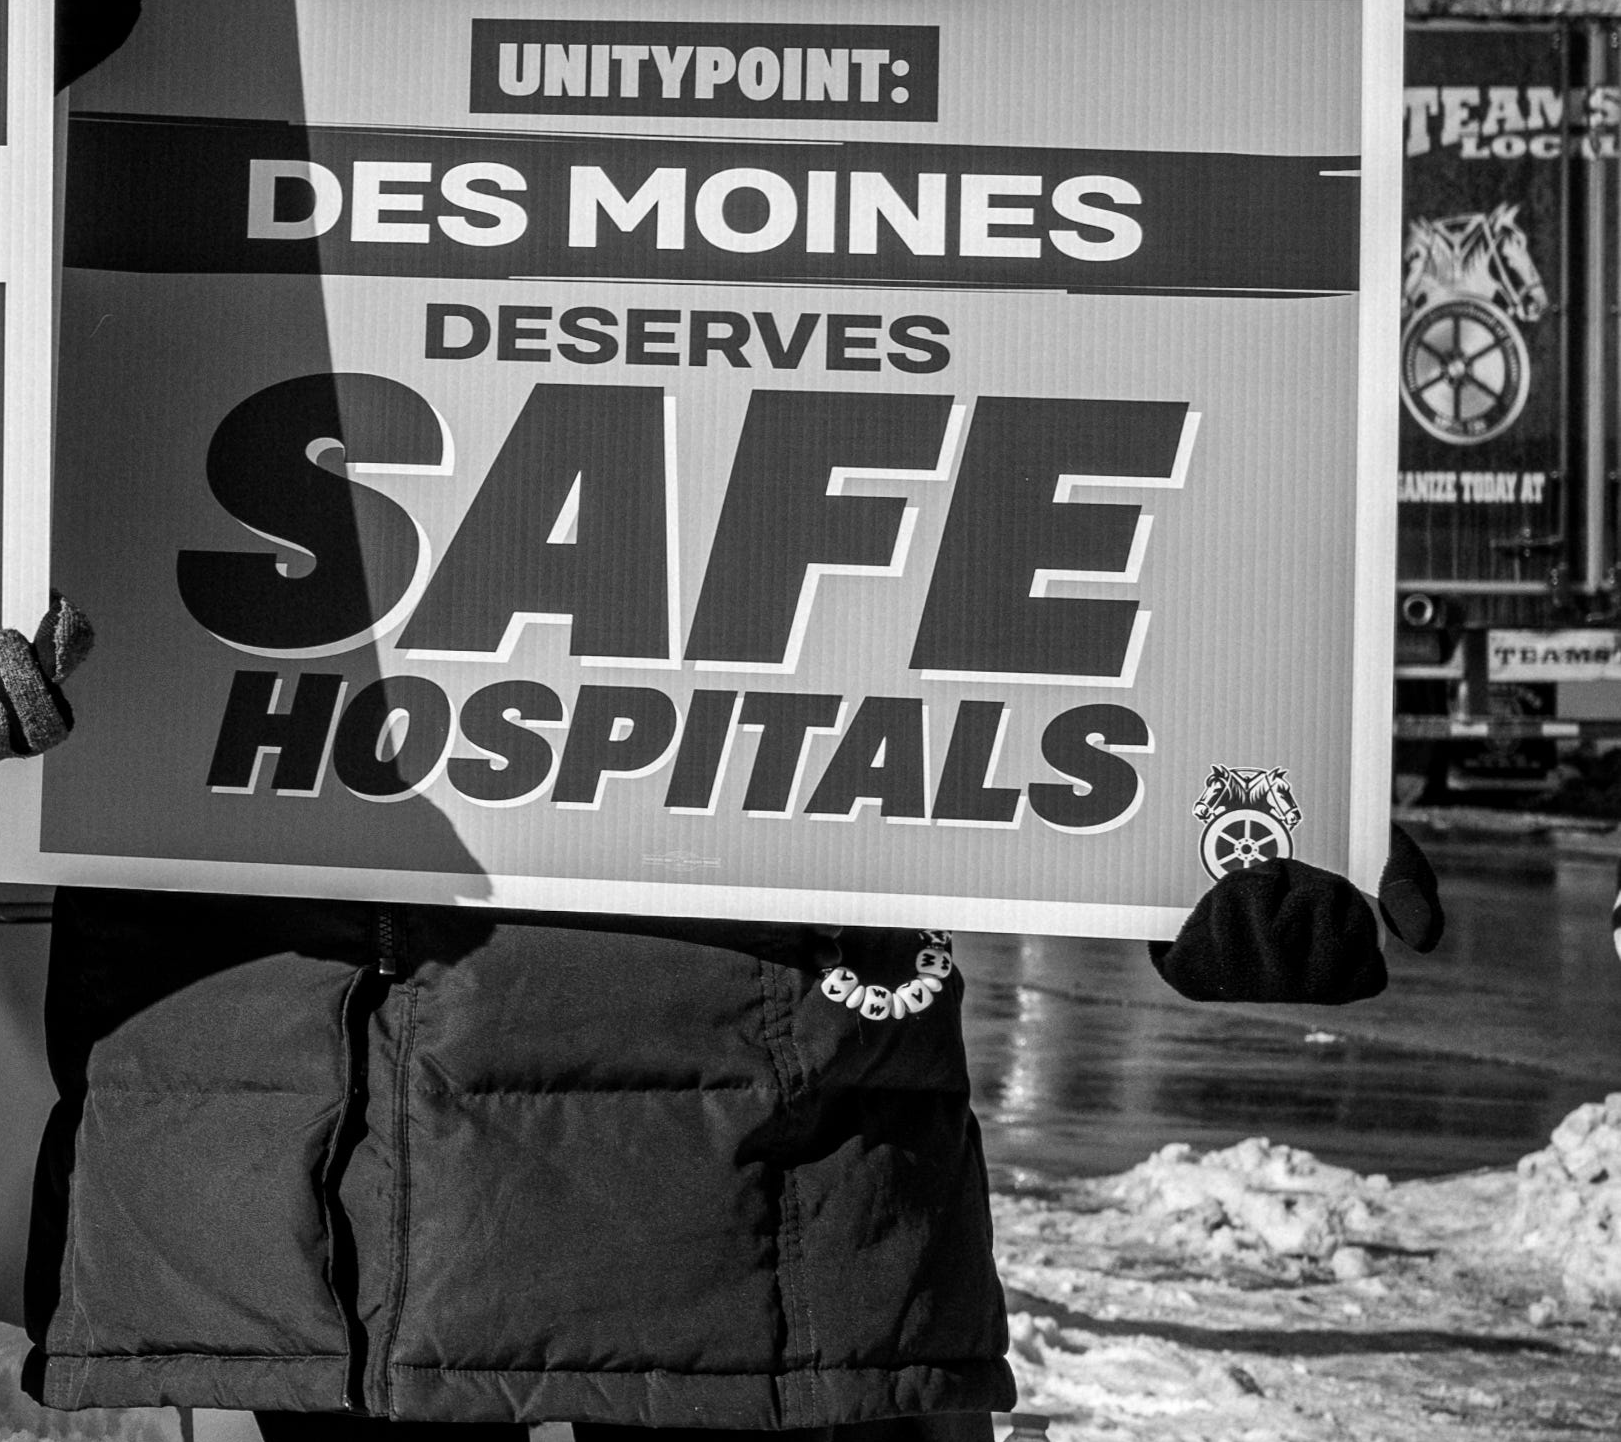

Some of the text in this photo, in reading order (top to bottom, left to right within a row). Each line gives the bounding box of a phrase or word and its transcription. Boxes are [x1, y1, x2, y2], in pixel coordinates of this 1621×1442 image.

[496, 40, 912, 105] UNITYPOINT:
[245, 157, 1144, 262] DES MOINES
[423, 301, 953, 375] DESERVES
[175, 370, 1203, 688] SAFE
[1460, 472, 1518, 503] TODAY
[1520, 472, 1546, 503] AT
[204, 669, 1155, 835] HOSPITALS
